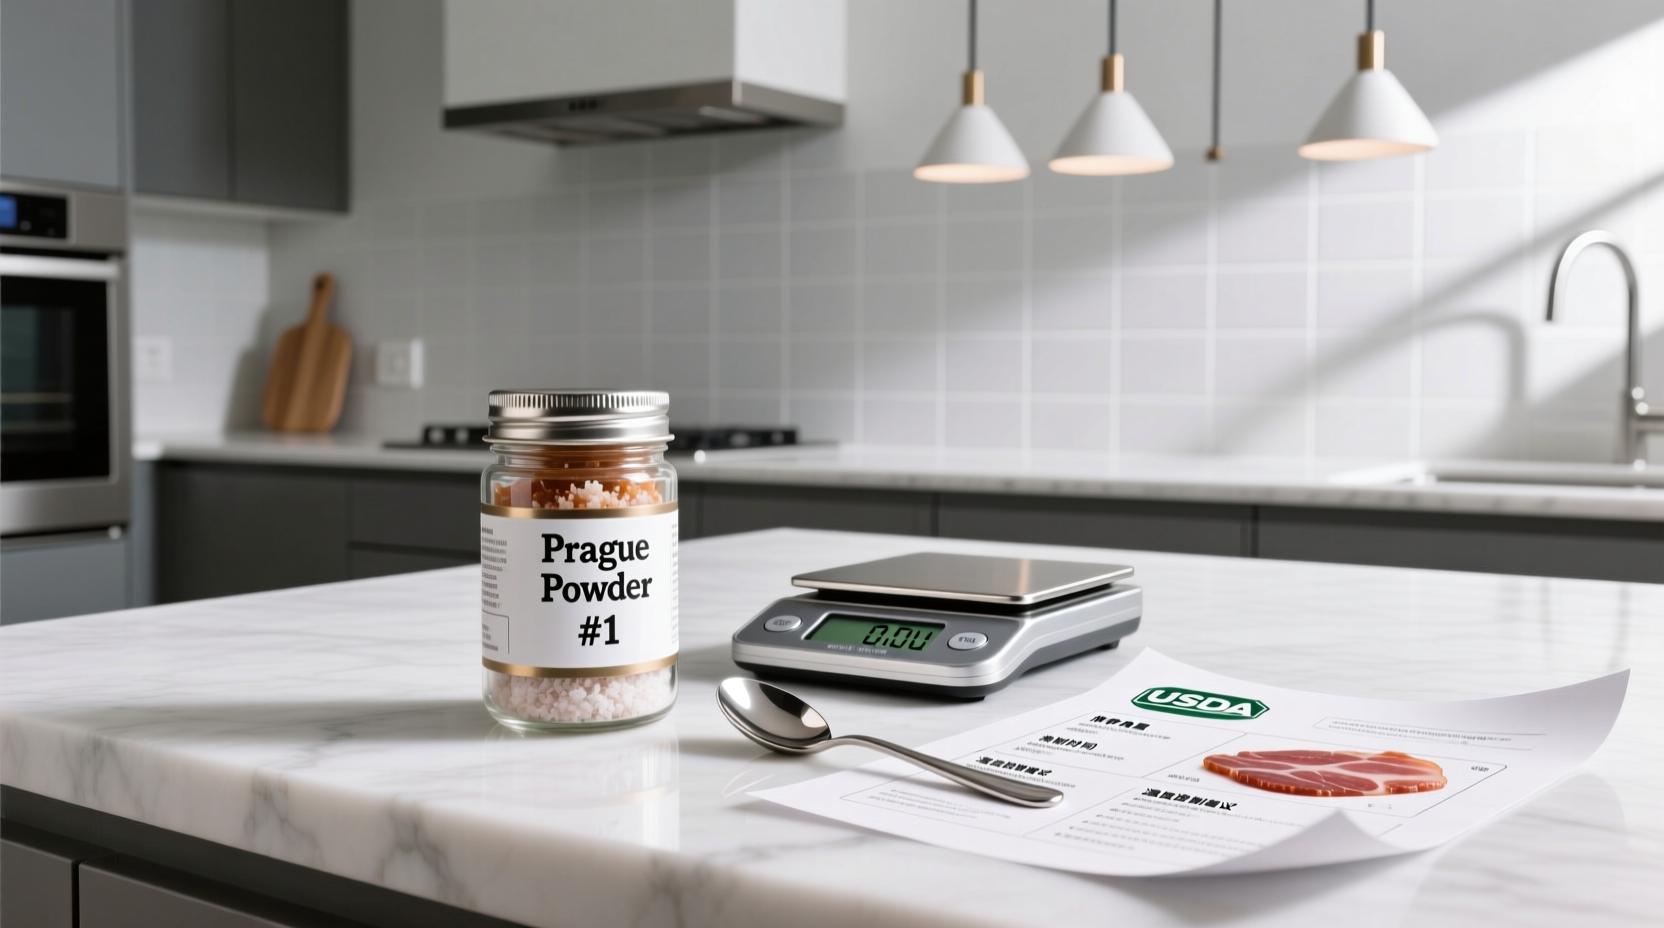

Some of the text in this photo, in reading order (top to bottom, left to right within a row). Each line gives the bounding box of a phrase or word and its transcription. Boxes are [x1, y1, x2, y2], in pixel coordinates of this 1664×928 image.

[541, 533, 650, 571] Prague
[540, 571, 653, 603] Powder
[578, 614, 620, 646] #1
[1147, 689, 1252, 717] USDA
